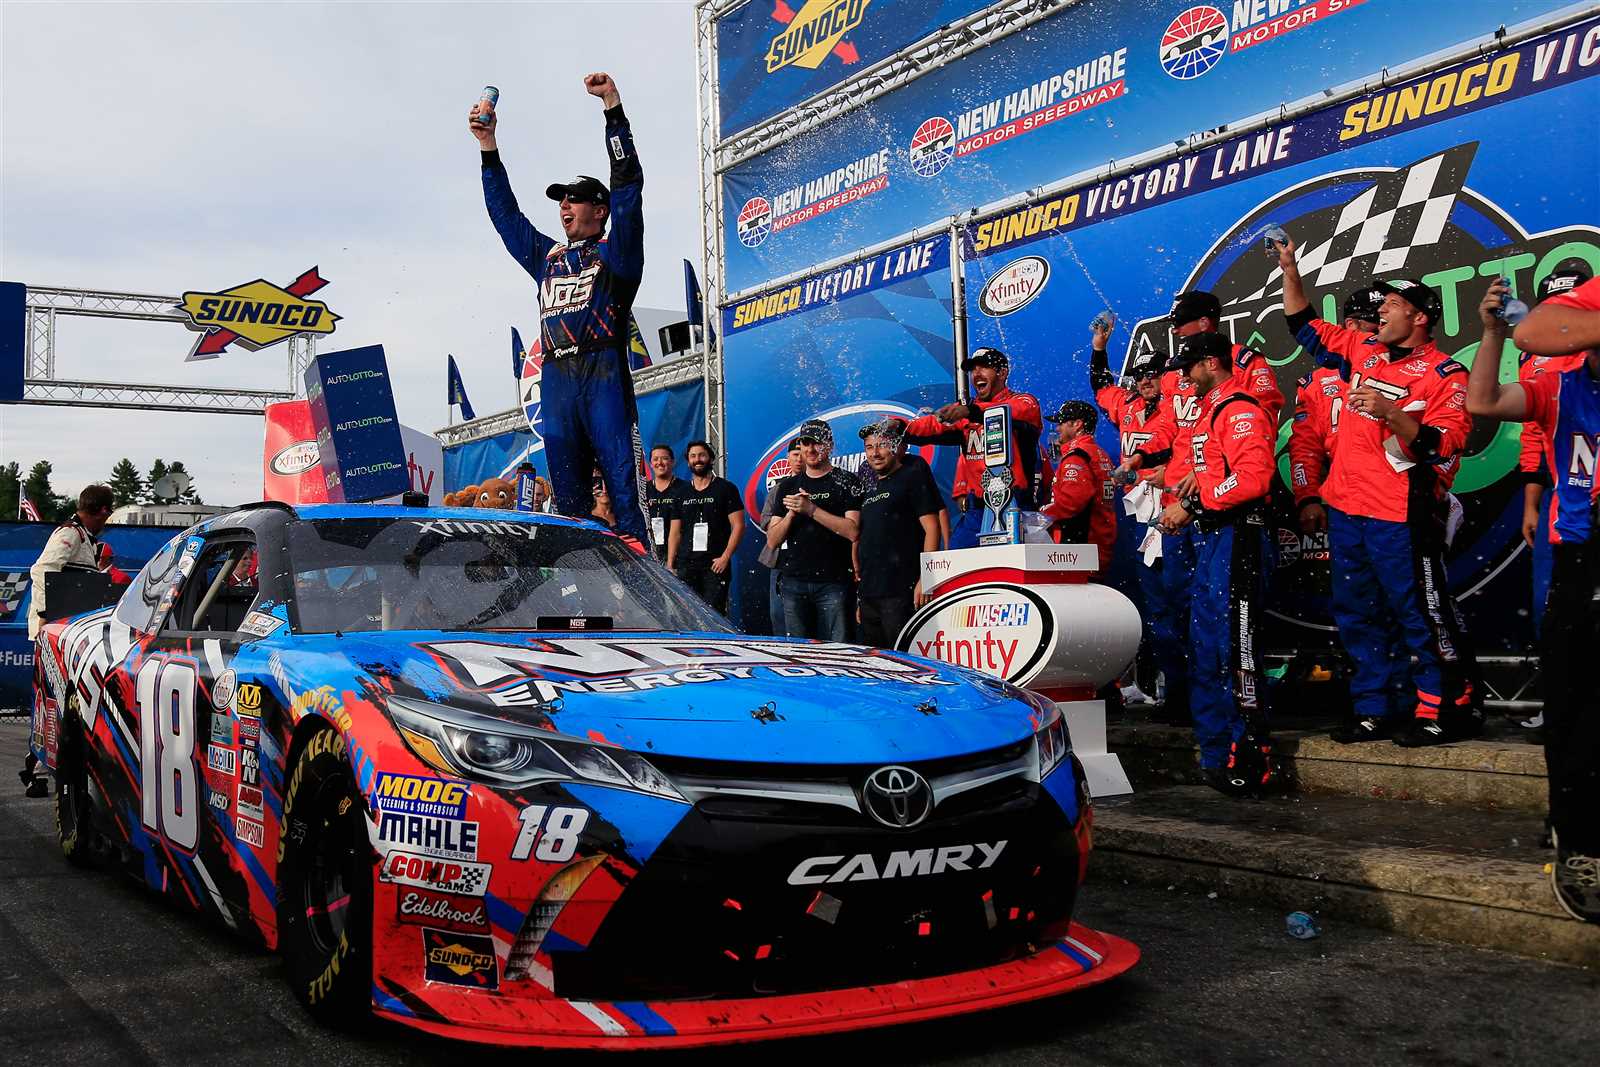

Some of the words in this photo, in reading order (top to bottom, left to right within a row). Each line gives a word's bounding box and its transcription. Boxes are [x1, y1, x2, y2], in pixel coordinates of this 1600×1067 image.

[769, 0, 863, 67] SUNOCO
[1233, 7, 1317, 50] MOTOR
[957, 100, 1001, 140] NEW
[1003, 47, 1127, 122] HAMPSHIRE
[1339, 52, 1521, 142] SUNOCO
[958, 124, 1016, 155] MOTOR
[1022, 83, 1121, 130] SPEEDWAY
[772, 186, 804, 217] NEW
[805, 148, 889, 203] HAMPSHIRE
[974, 194, 1080, 252] SUNOCO
[1085, 156, 1199, 218] VICTORY
[1211, 125, 1295, 181] LANE
[773, 208, 813, 232] MOTOR
[818, 177, 885, 213] SPEEDWAY
[541, 262, 601, 312] NOS
[733, 286, 801, 329] SUNOCO
[804, 261, 875, 305] VICTORY
[882, 241, 935, 281] LANE
[990, 277, 1034, 303] xfinity
[1547, 275, 1577, 291] NOS
[196, 299, 324, 328] SUNOCO
[563, 301, 589, 313] DRINK
[1173, 394, 1202, 421] NO
[521, 474, 534, 508] NOS
[1213, 473, 1238, 498] NOS
[1568, 477, 1591, 487] ENE
[410, 519, 537, 540] xfinity
[925, 559, 951, 573] xfinity
[1048, 552, 1078, 565] xfinity
[974, 603, 1028, 627] NASCAR
[1240, 600, 1249, 652] PERFORMANCE
[916, 630, 1019, 680] xfinity
[488, 667, 751, 707] ENERGY
[776, 666, 958, 686] DRINK
[1239, 670, 1257, 707] NOS
[136, 659, 197, 850] 18
[209, 792, 228, 810] MSD
[377, 775, 467, 805] MOOG
[379, 797, 408, 811] STEERING
[417, 802, 459, 817] SUSPENSION
[238, 819, 263, 847] SIMPSON
[379, 812, 477, 853] MAHLE
[512, 806, 588, 863] 18
[389, 855, 462, 882] COMP
[787, 840, 1008, 886] CAMRY
[436, 881, 474, 893] CAMS
[401, 893, 485, 925] Edelbrock
[308, 929, 349, 1005] EAGLE
[432, 950, 491, 967] SUNOCO
